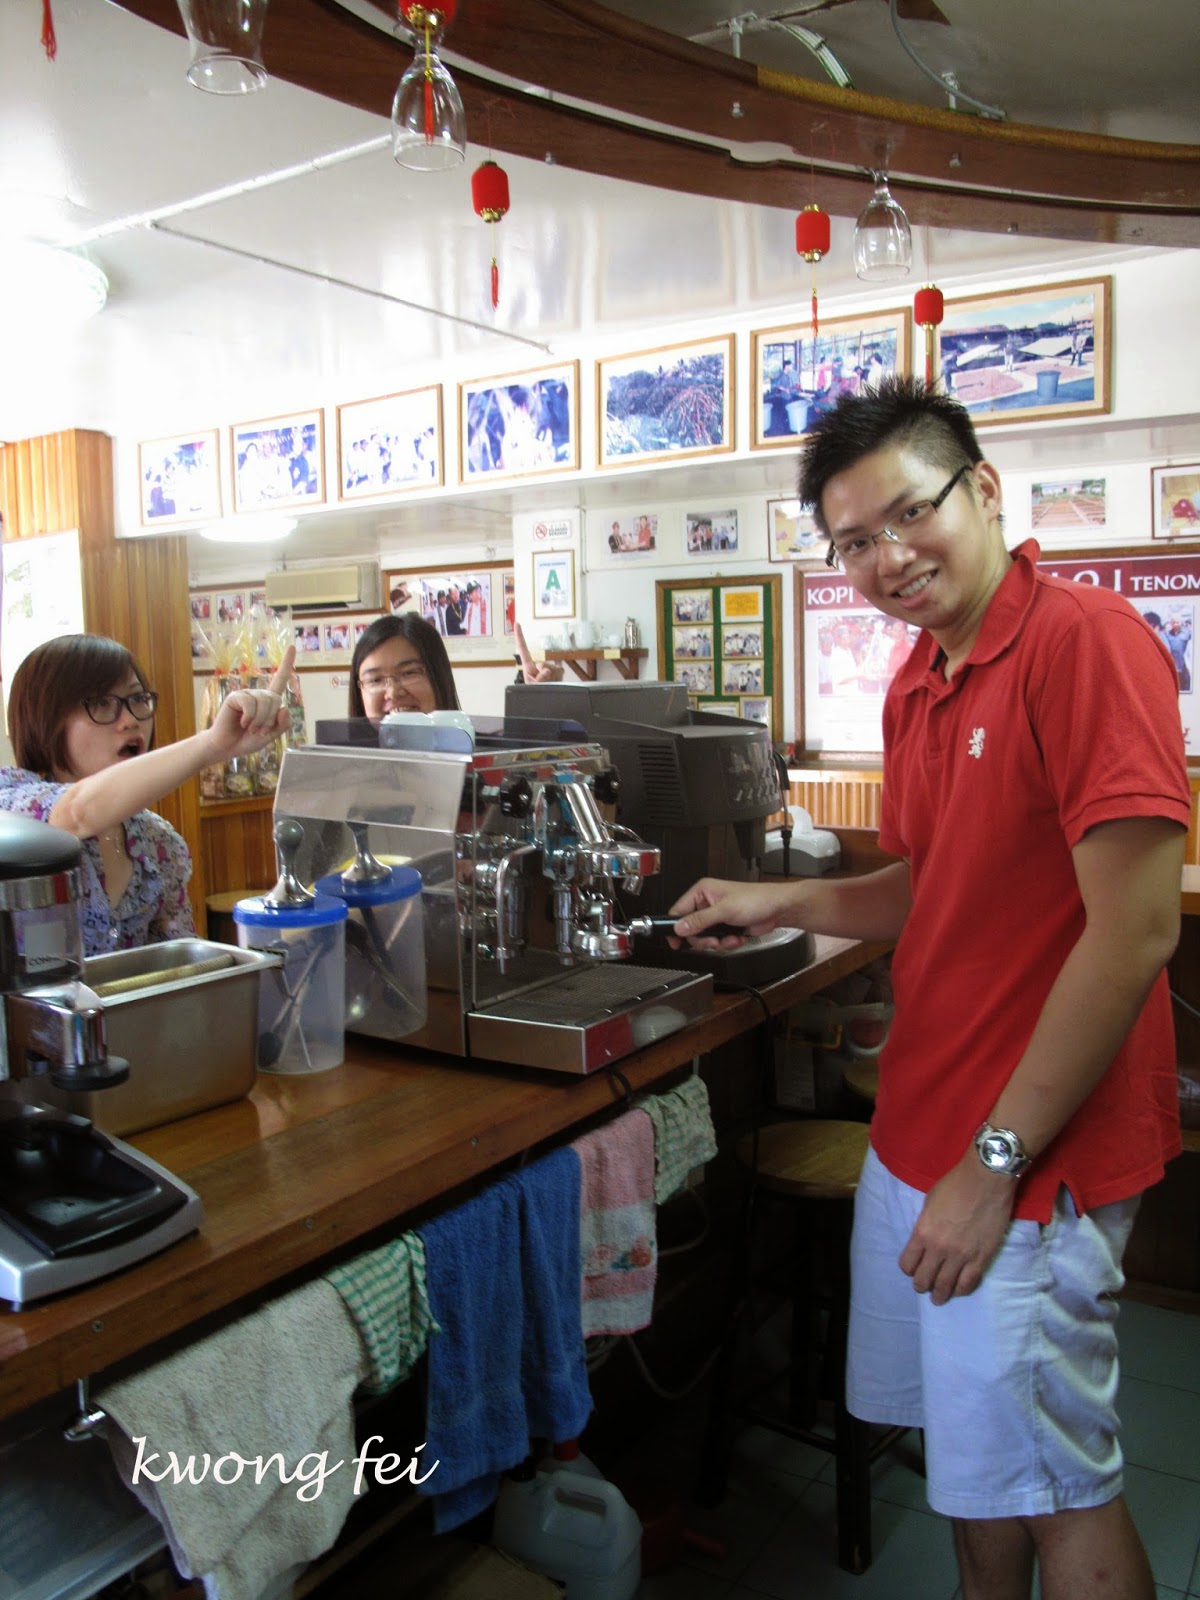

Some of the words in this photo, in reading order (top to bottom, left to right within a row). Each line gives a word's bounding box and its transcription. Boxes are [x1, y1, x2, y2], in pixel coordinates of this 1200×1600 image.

[545, 569, 561, 590] A
[806, 586, 854, 606] KOPI
[1129, 574, 1200, 592] TENOM
